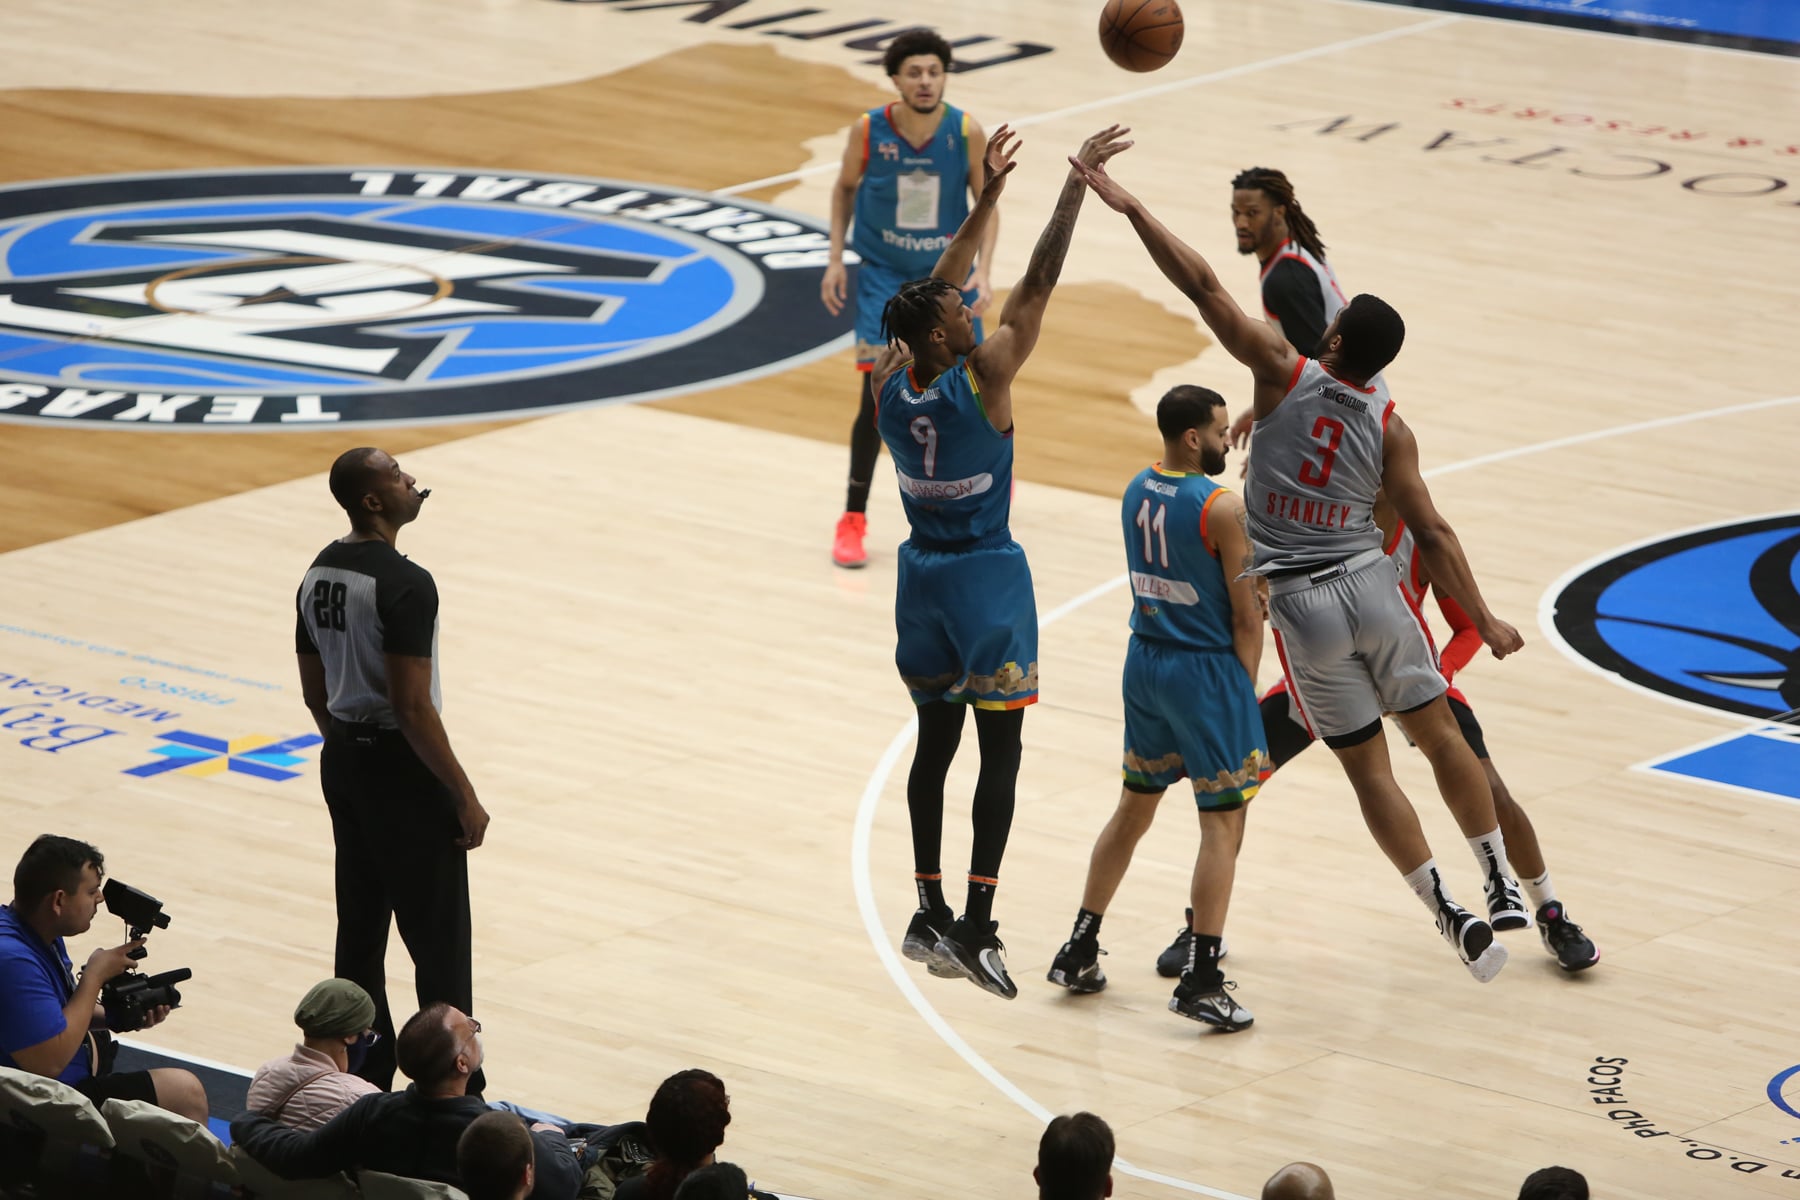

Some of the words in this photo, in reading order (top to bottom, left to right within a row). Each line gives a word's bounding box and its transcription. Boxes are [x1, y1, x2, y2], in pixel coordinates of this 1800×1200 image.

[543, 0, 1053, 75] thriv
[1273, 113, 1800, 207] OCTAW
[350, 171, 862, 270] BASKETBALL
[0, 383, 341, 423] TEXAS
[910, 415, 938, 479] 9
[1298, 416, 1344, 488] 3
[905, 479, 973, 499] LAWSON
[1266, 492, 1352, 529] STANLEY
[1136, 498, 1169, 569] 11
[313, 579, 348, 633] 28
[1134, 575, 1171, 599] ILLER
[119, 675, 237, 707] FRISCO
[1586, 1056, 1629, 1105] FACOS
[1606, 1109, 1671, 1139] PhD
